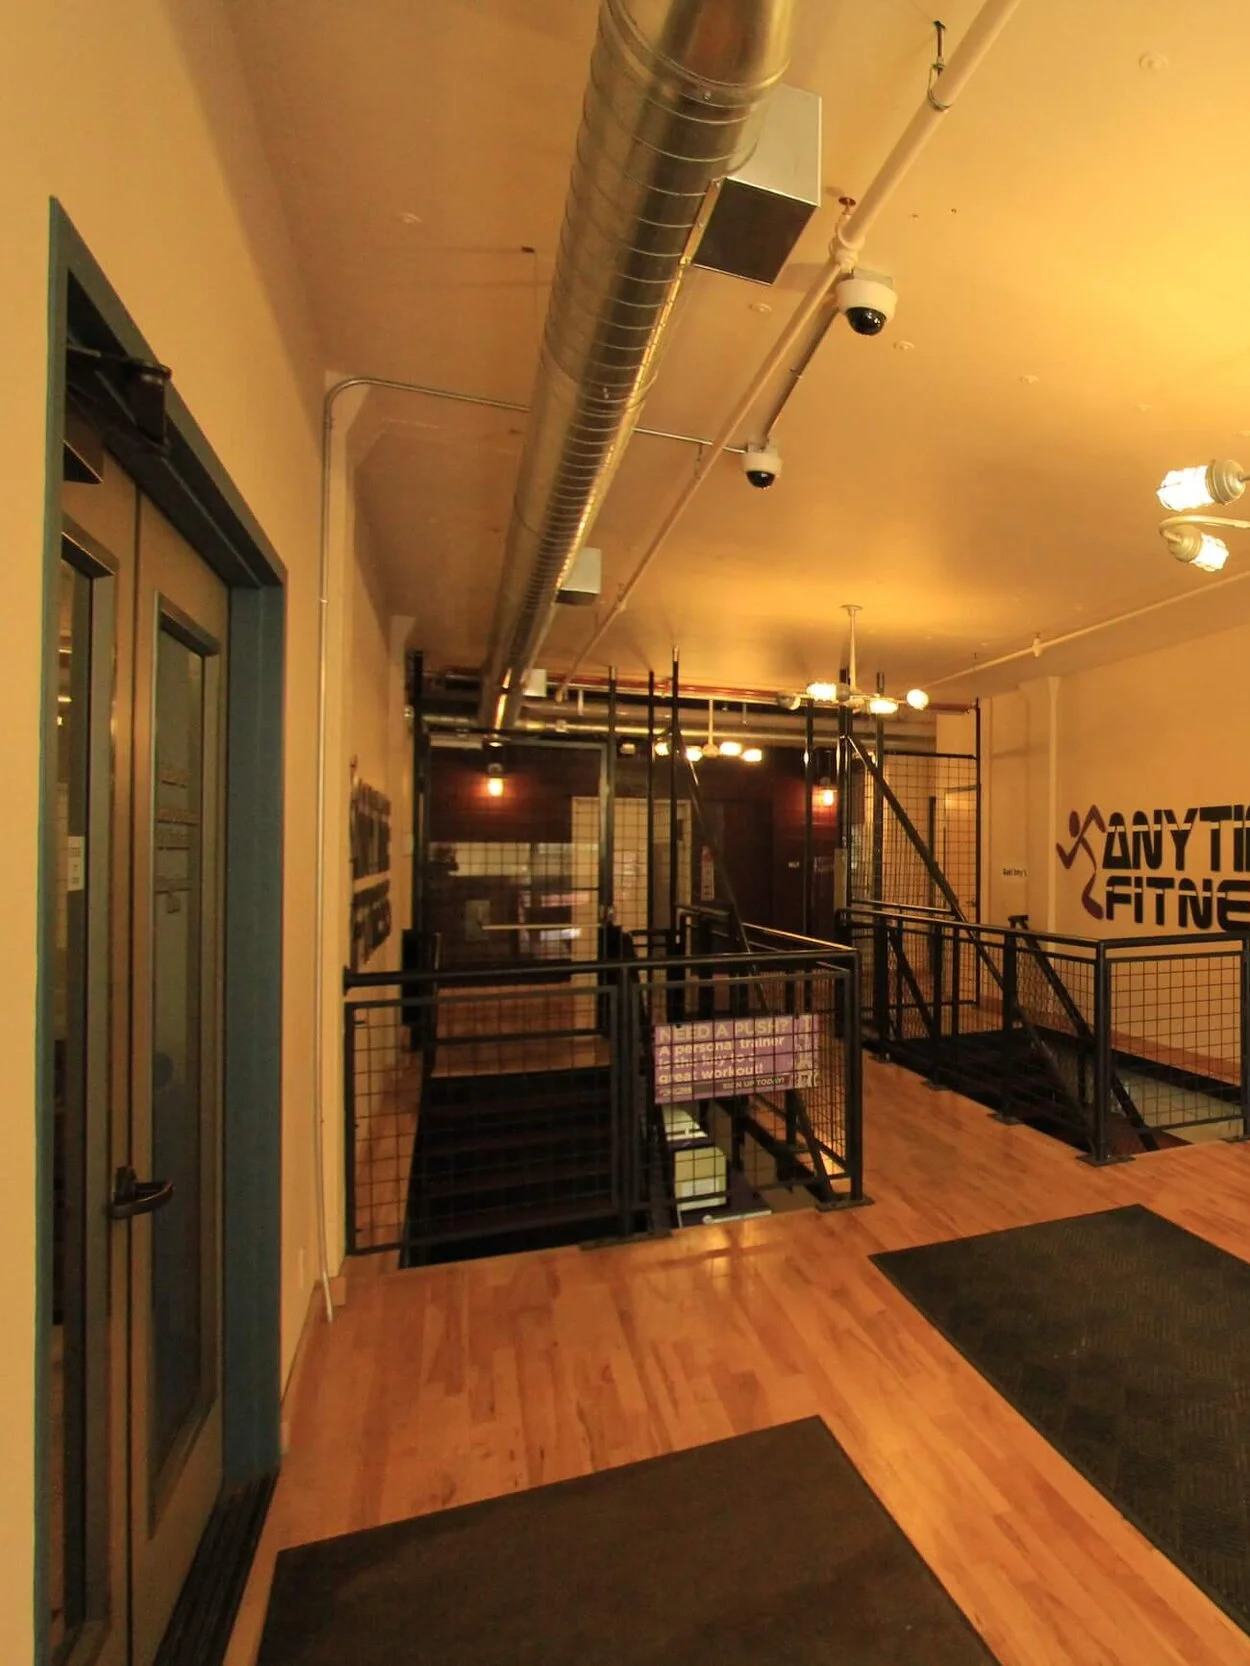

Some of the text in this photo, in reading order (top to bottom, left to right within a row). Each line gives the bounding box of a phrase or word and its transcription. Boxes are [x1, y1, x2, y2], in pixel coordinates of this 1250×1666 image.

[660, 1020, 789, 1042] NEED A PUSH?
[659, 1046, 670, 1056] A
